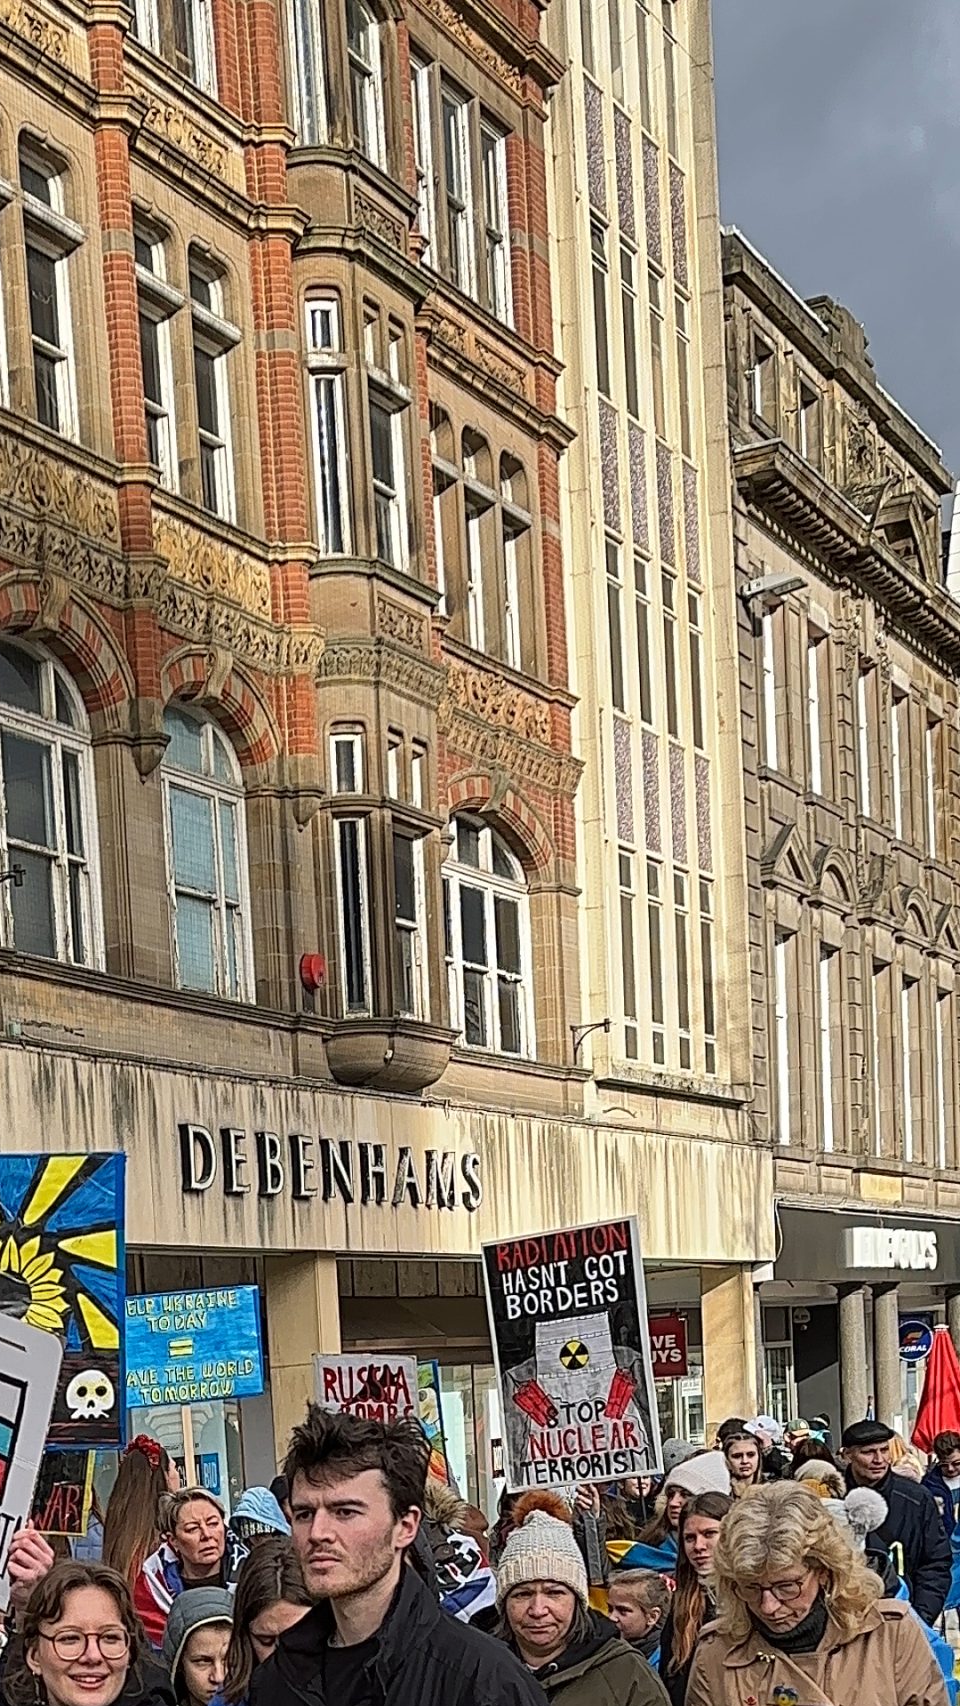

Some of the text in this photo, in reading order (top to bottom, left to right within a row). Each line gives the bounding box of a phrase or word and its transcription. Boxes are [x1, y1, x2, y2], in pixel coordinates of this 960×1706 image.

[178, 1123, 483, 1212] DEBENHAMS
[497, 1222, 628, 1272] RADIATION
[502, 1250, 628, 1296] HASN'T GOT
[127, 1290, 238, 1317] ELP UKRAINE
[506, 1278, 619, 1320] BORDERS
[126, 1359, 254, 1388] AVE THE WORLD
[141, 1380, 235, 1405] TOMORROW
[322, 1365, 412, 1405] RUSSIA
[545, 1400, 606, 1429] STOP
[528, 1421, 638, 1460] NUCLEAR
[522, 1447, 650, 1486] TERRORISM
